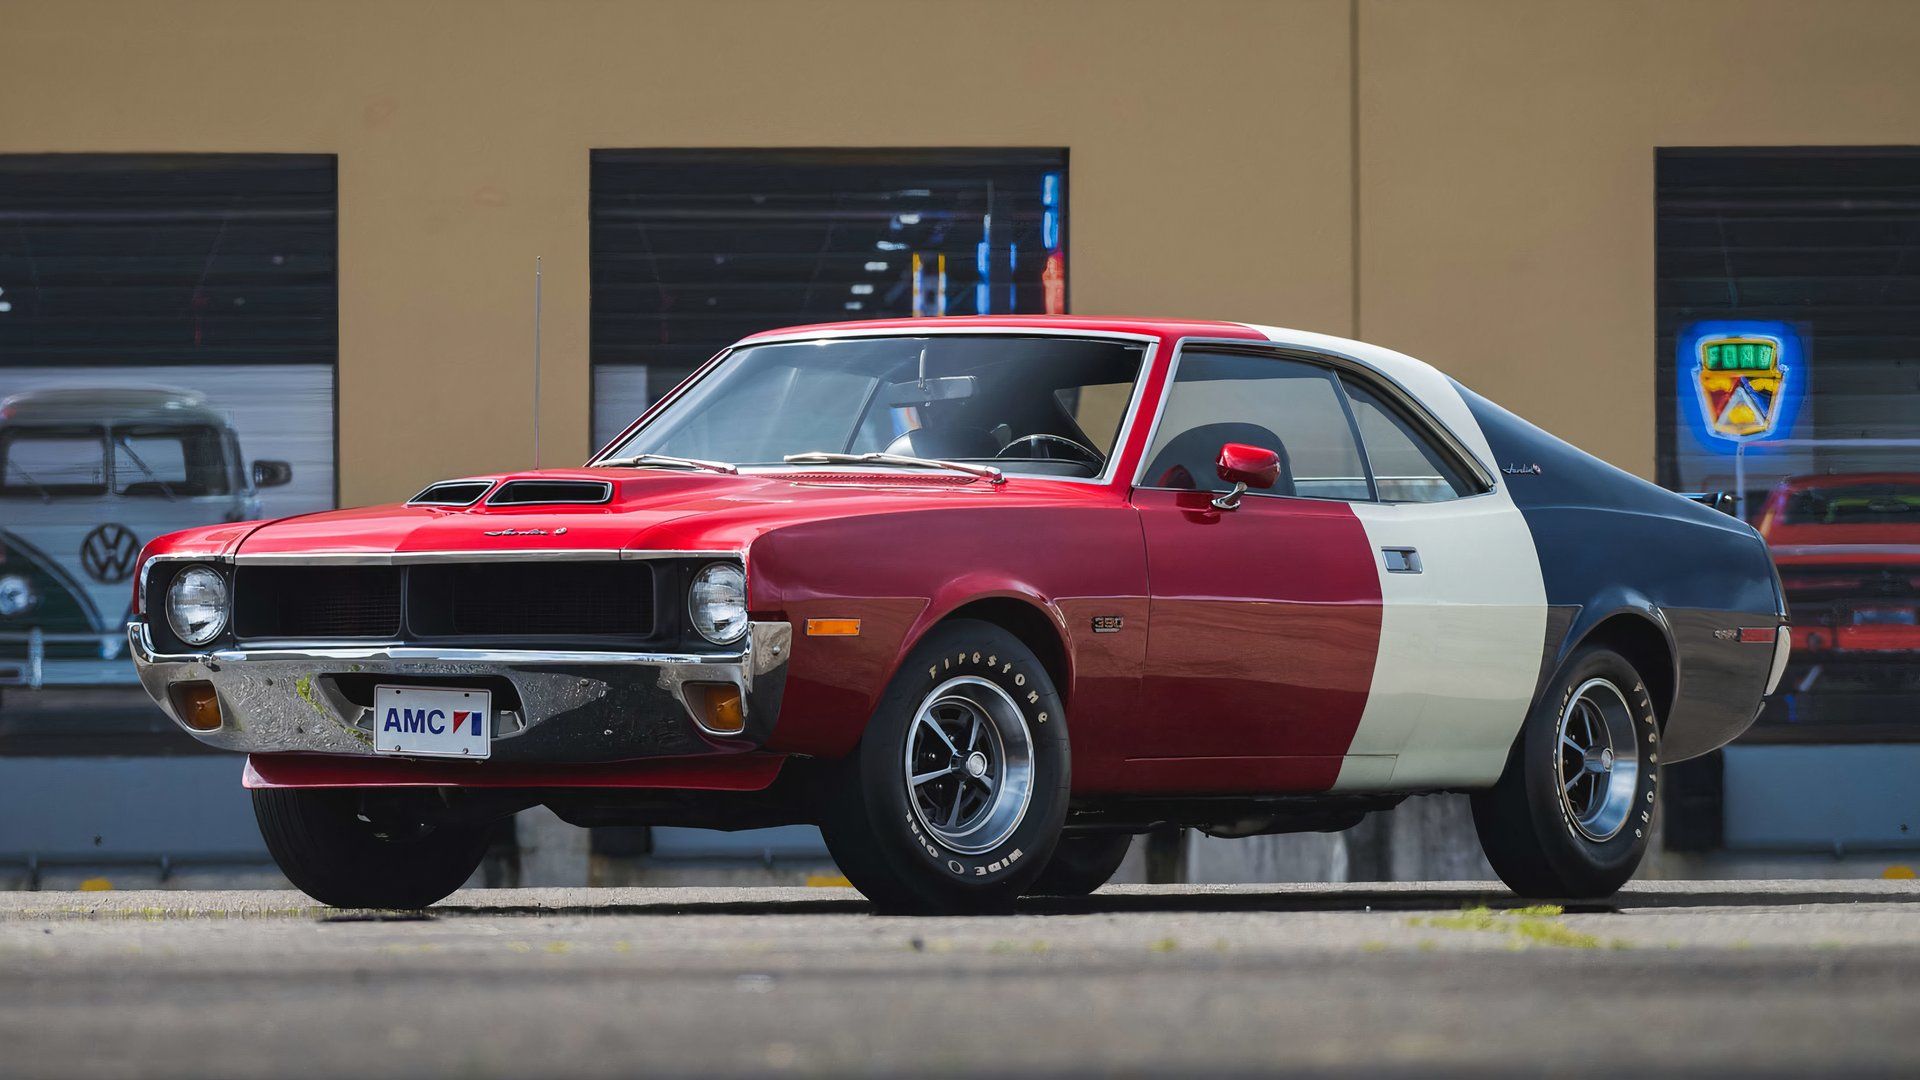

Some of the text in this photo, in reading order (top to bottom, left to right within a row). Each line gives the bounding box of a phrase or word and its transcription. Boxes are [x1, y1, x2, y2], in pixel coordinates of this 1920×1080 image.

[384, 707, 445, 734] AMC
[904, 809, 1023, 876] WIDE OVAL
